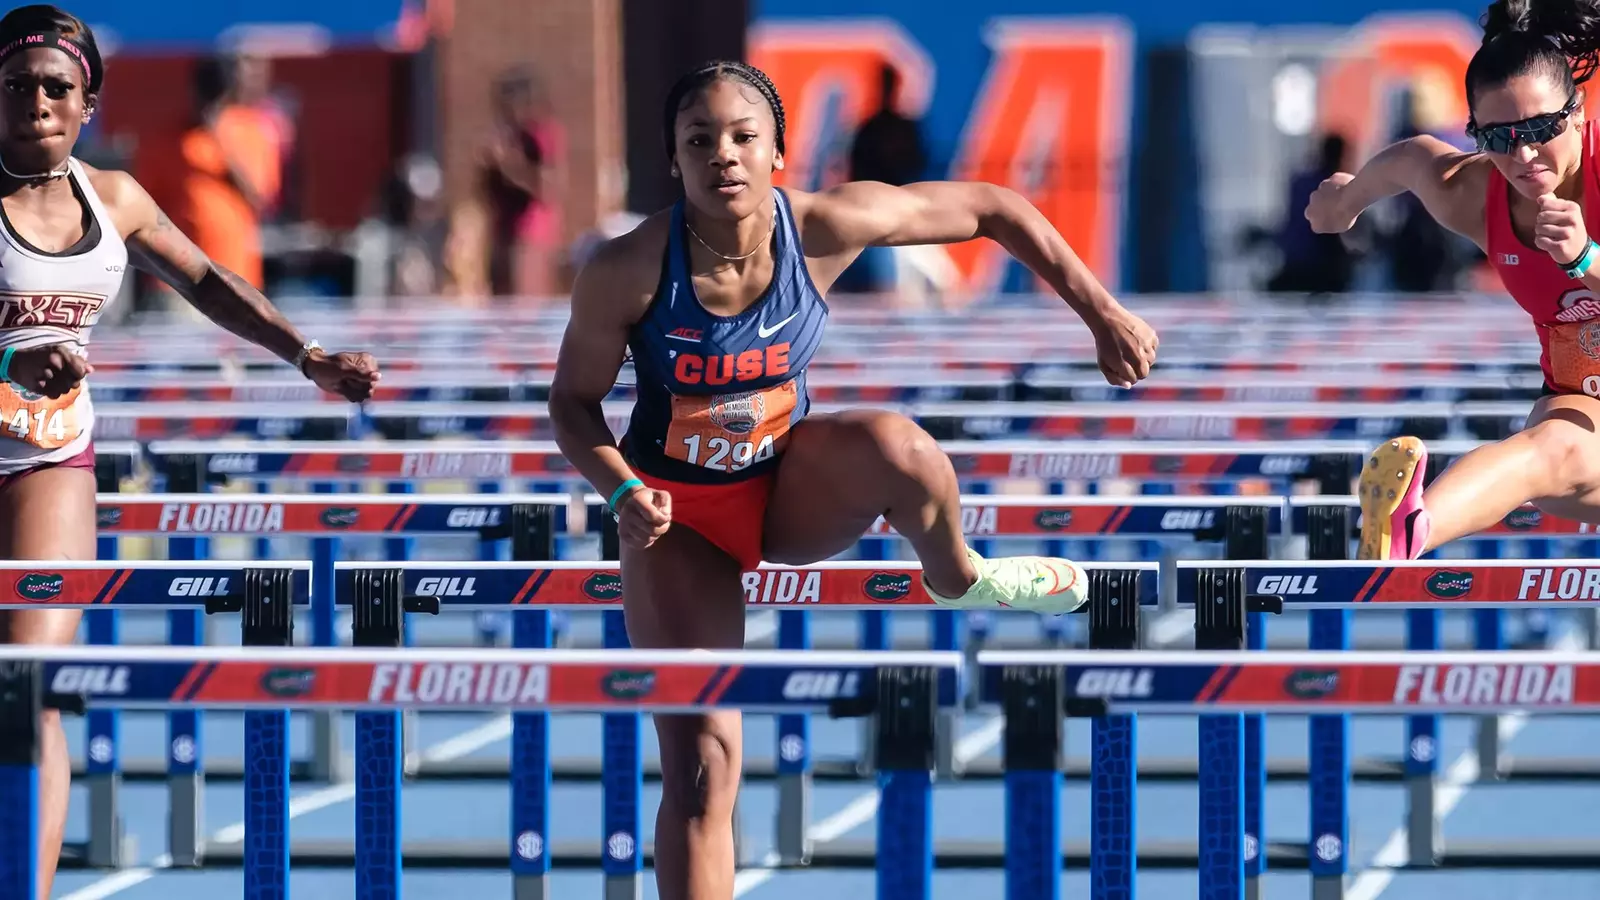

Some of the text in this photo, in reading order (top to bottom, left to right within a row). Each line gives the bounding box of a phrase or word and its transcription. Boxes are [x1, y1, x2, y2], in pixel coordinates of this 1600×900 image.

[26, 35, 44, 43] ME
[684, 434, 775, 471] 1294
[158, 503, 500, 532] FLORIDA GILL
[1161, 510, 1214, 529] GILL
[168, 577, 229, 596] GILL
[415, 571, 821, 602] GILL RIDA
[1256, 575, 1318, 595] GILL
[52, 664, 858, 703] GILL FLORIDA GILL
[1077, 665, 1574, 704] GILL FLORIDA
